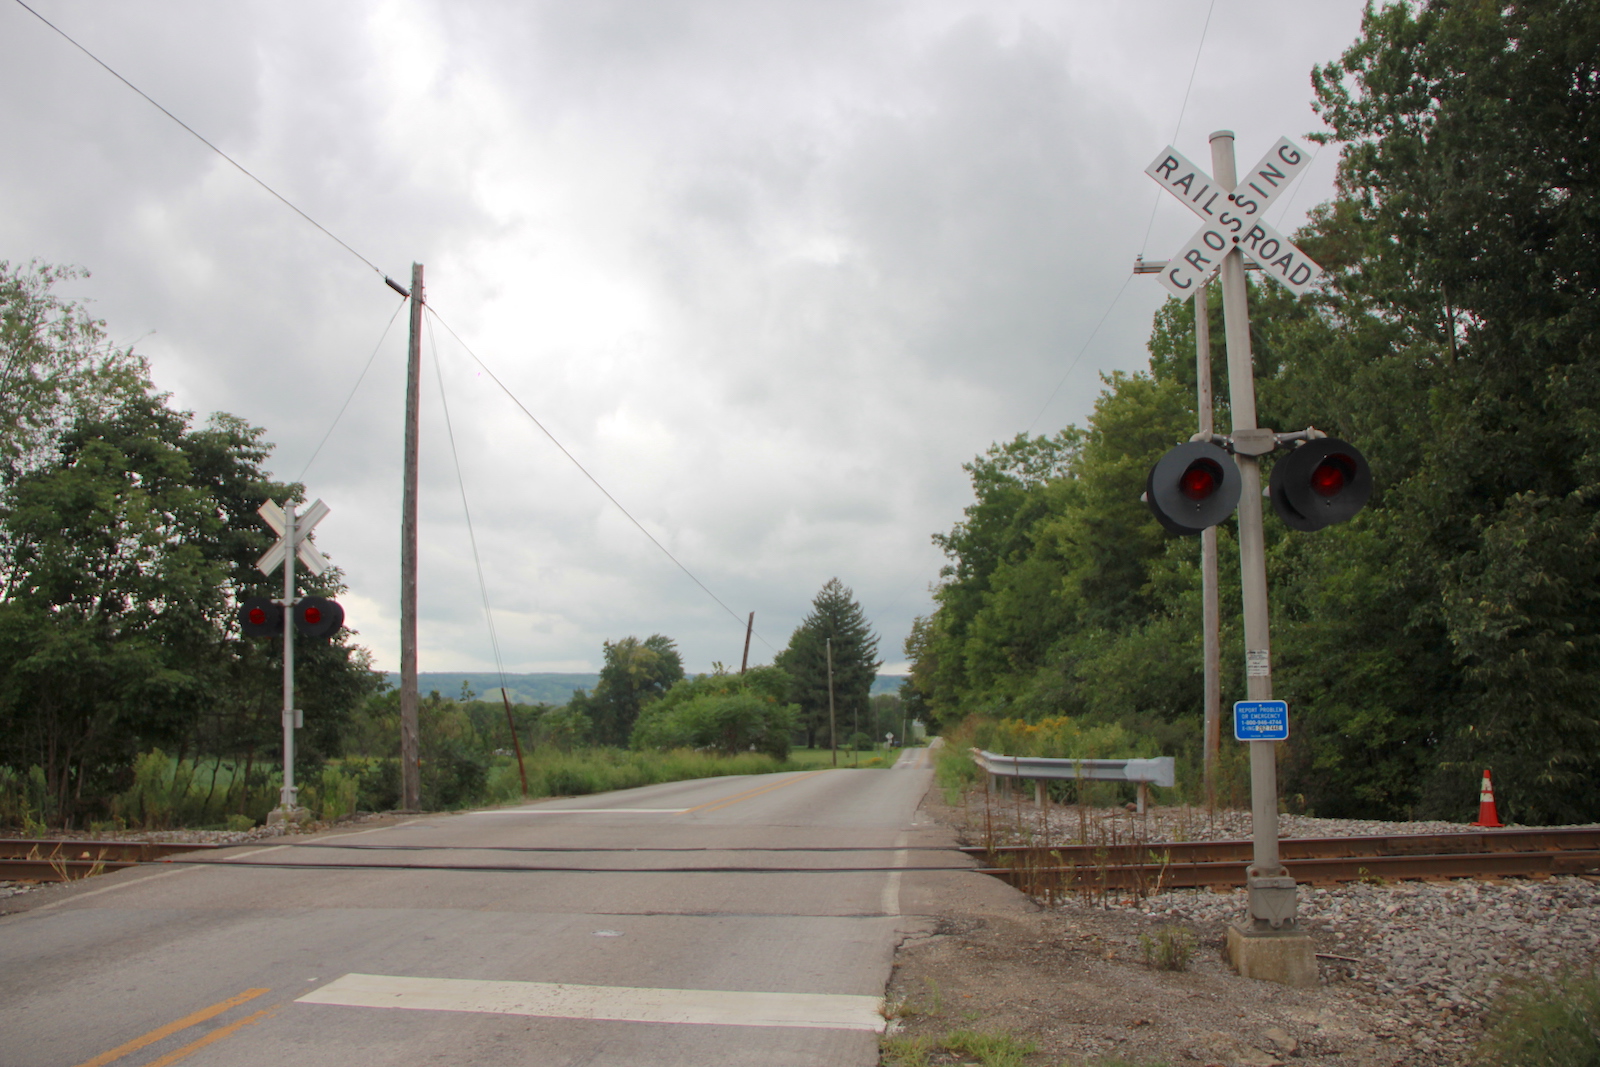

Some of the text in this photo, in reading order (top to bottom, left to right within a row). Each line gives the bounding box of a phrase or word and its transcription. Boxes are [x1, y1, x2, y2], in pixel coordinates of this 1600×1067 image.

[1155, 155, 1312, 286] RAIL ROAD
[1168, 145, 1302, 290] CROSSING
